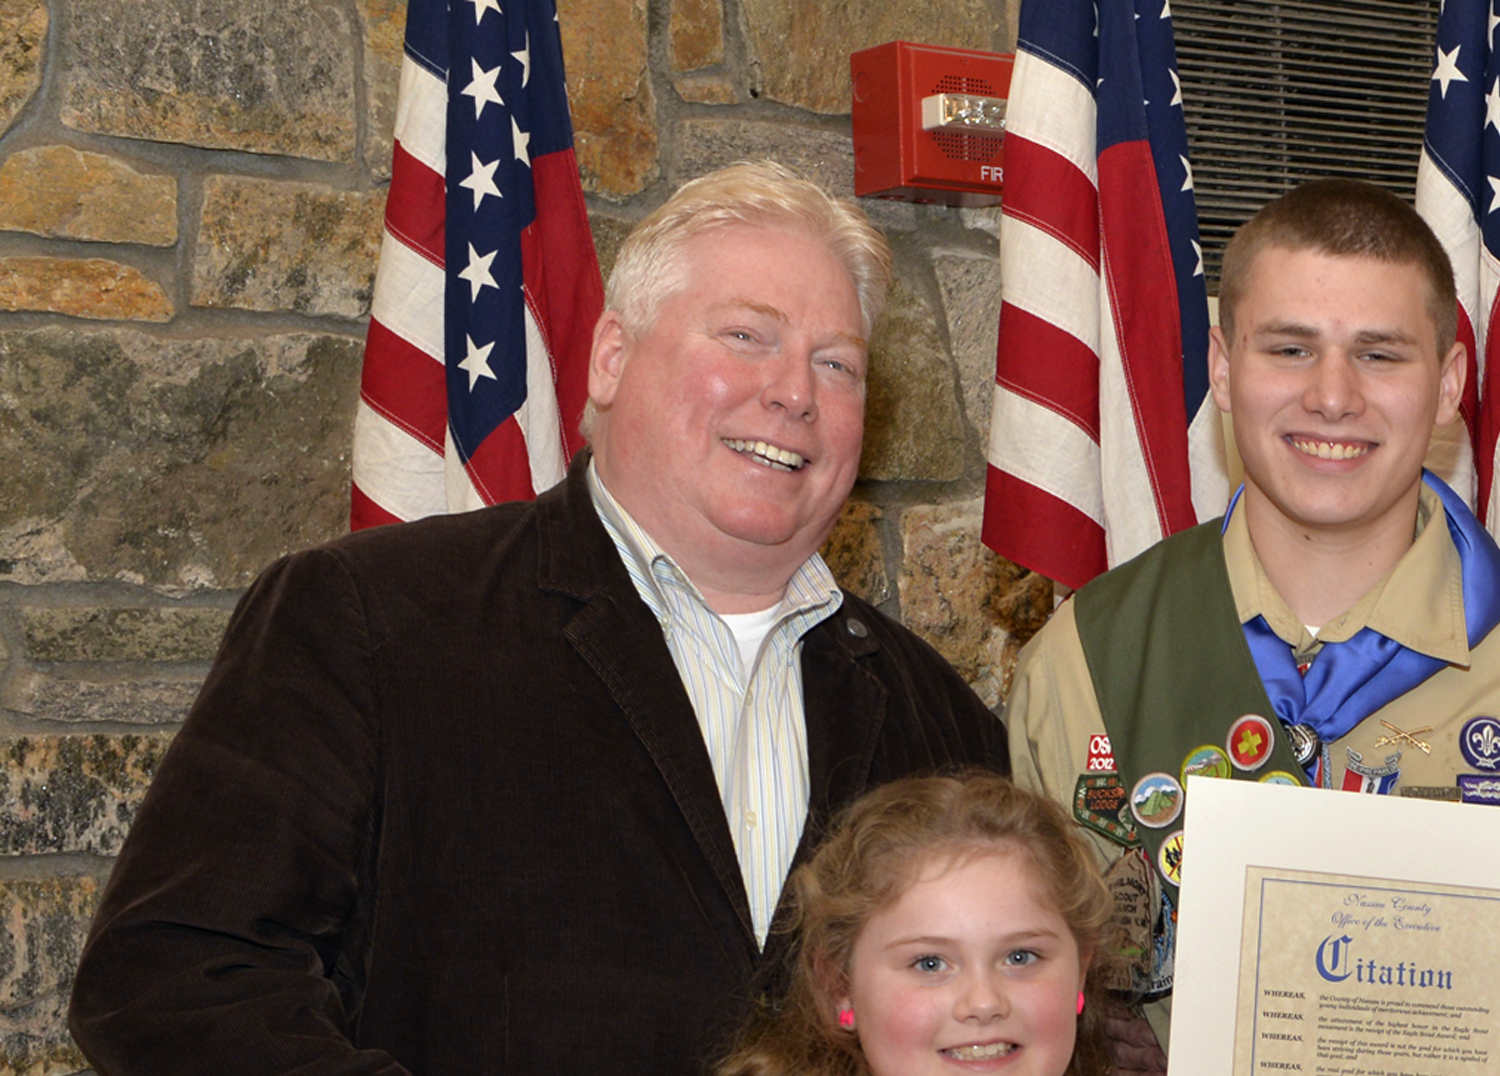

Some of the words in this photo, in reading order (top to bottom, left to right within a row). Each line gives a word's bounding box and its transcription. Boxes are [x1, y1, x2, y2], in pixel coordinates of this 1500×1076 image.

[981, 166, 1003, 181] FIR
[1089, 757, 1114, 770] 2012
[1343, 892, 1385, 908] Nassau
[1390, 896, 1432, 916] County
[1331, 910, 1360, 929] Office
[1362, 915, 1375, 931] of
[1374, 916, 1388, 927] the
[1393, 916, 1441, 933] Executive
[1315, 934, 1453, 991] Citation
[1264, 990, 1305, 999] WHEREAS,
[1262, 1011, 1304, 1020] WHEREAS,
[1261, 1032, 1303, 1041] WHEREAS,
[1260, 1061, 1301, 1070] WHEREAS,
